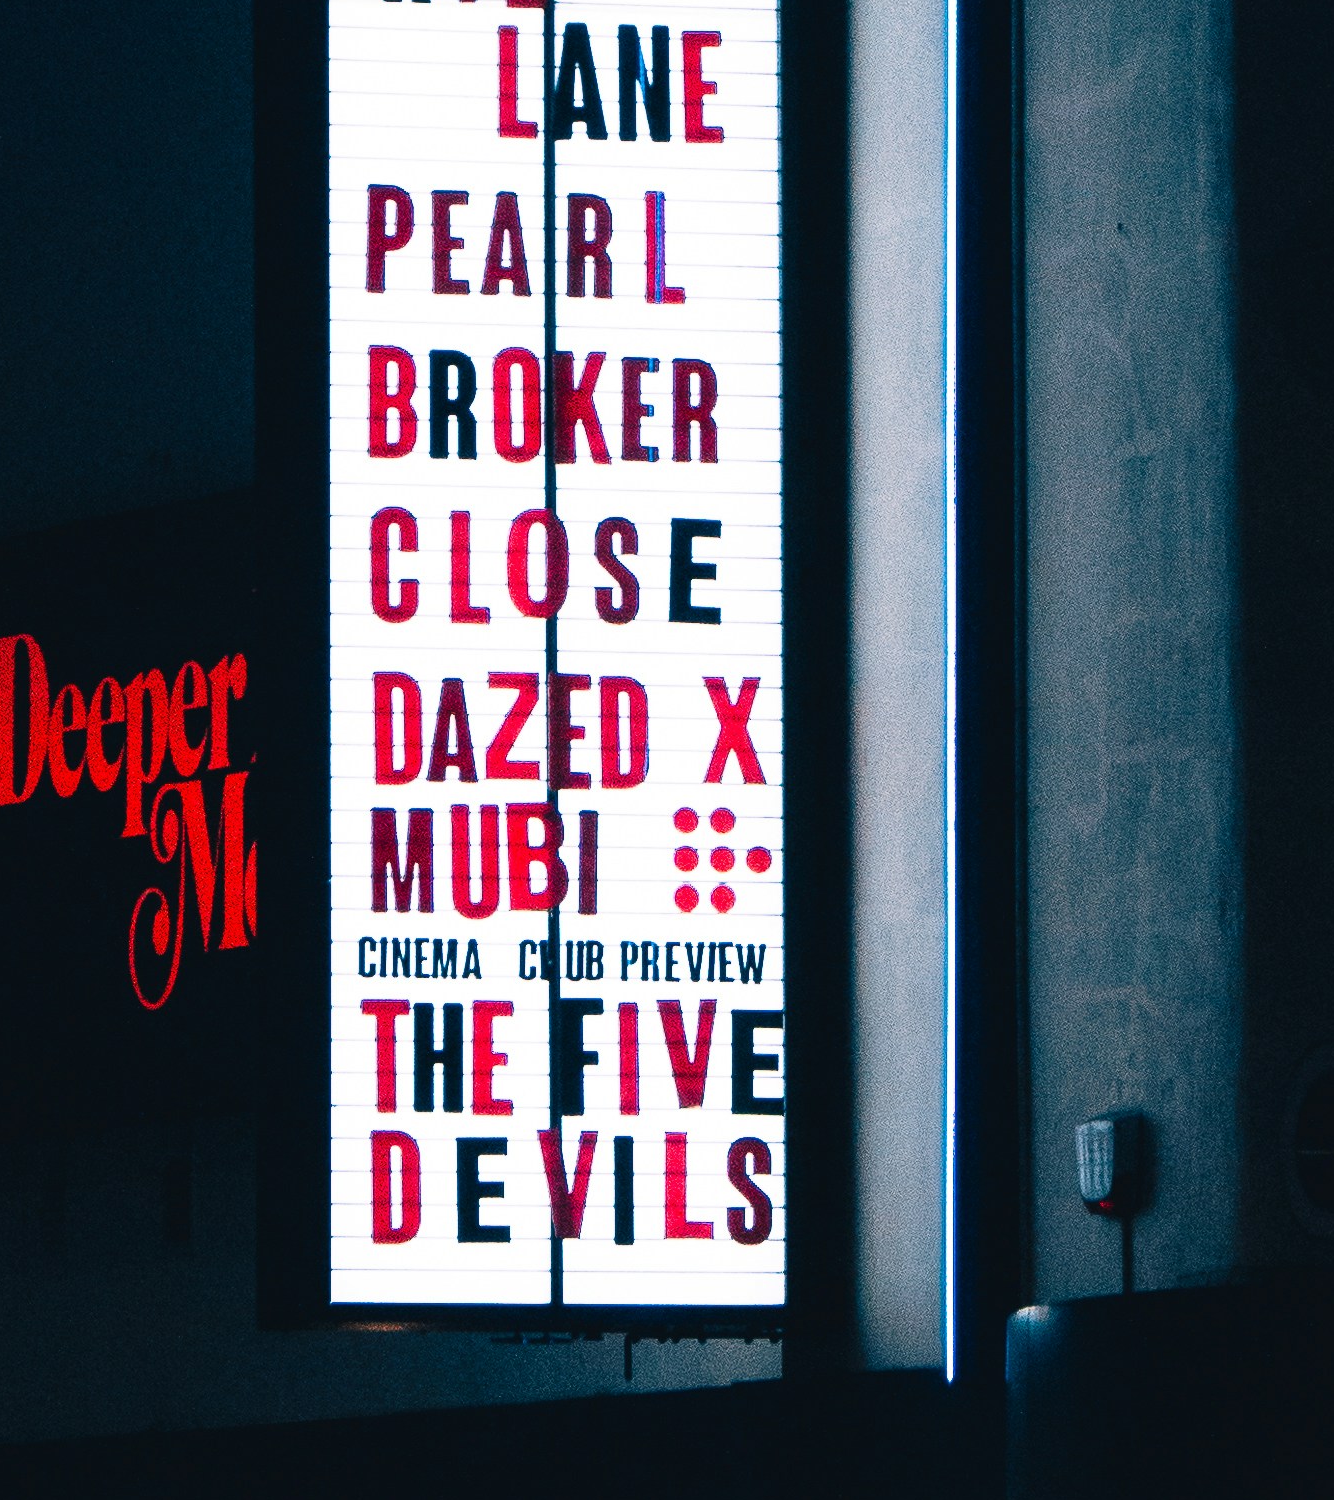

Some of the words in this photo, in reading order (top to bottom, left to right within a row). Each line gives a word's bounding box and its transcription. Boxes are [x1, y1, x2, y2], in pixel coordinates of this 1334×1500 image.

[497, 22, 725, 143] LANE
[365, 183, 686, 304] PEARL
[367, 344, 719, 465] BROKER
[369, 506, 722, 625] CLOSE
[372, 671, 650, 790] DAZED
[701, 676, 767, 785] X
[370, 802, 599, 920] MUBI
[357, 936, 482, 980] CINEMA
[620, 940, 767, 985] PREVIEW
[360, 999, 515, 1116] THE
[556, 997, 786, 1116] FIVE
[370, 1129, 773, 1245] DEVILS
